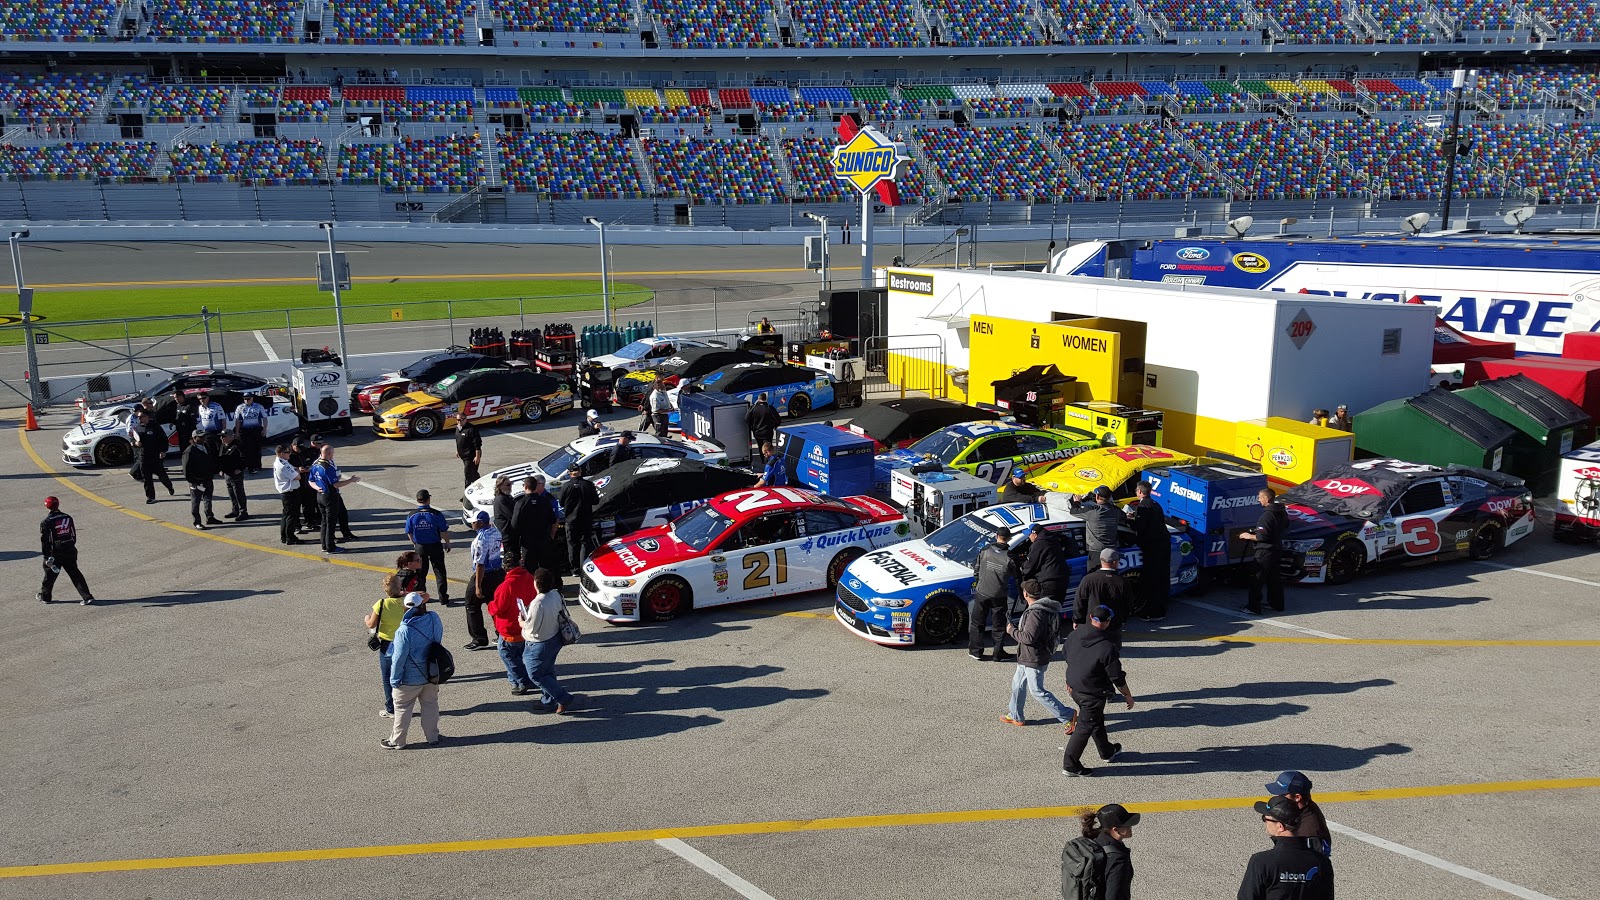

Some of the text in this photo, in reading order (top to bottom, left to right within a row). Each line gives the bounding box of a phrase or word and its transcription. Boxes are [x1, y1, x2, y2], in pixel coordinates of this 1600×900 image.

[837, 151, 892, 172] SUNOCO
[1182, 249, 1203, 259] Ford
[1177, 263, 1227, 272] PERFORMANCE
[890, 275, 932, 292] Restrooms
[973, 321, 994, 335] MEN
[1291, 321, 1313, 337] 209
[1062, 334, 1107, 353] WOMEN
[466, 396, 502, 419] 32
[693, 412, 711, 438] Lite
[1111, 419, 1121, 430] 27
[778, 433, 786, 447] 5
[807, 452, 829, 465] FARMERS
[1023, 445, 1089, 465] MENARDS
[1271, 454, 1293, 464] PENNZOIL
[977, 460, 1013, 490] 27
[1169, 481, 1204, 503] FASTENAL
[1323, 480, 1371, 494] DOW
[723, 487, 806, 513] 21
[1211, 493, 1260, 511] FASTENAL
[816, 526, 892, 549] Quick Lane
[1211, 540, 1226, 552] 17
[1401, 517, 1442, 557] 3
[742, 547, 788, 590] 21
[864, 550, 921, 586] FASTENAL
[1280, 866, 1306, 880] alcon
